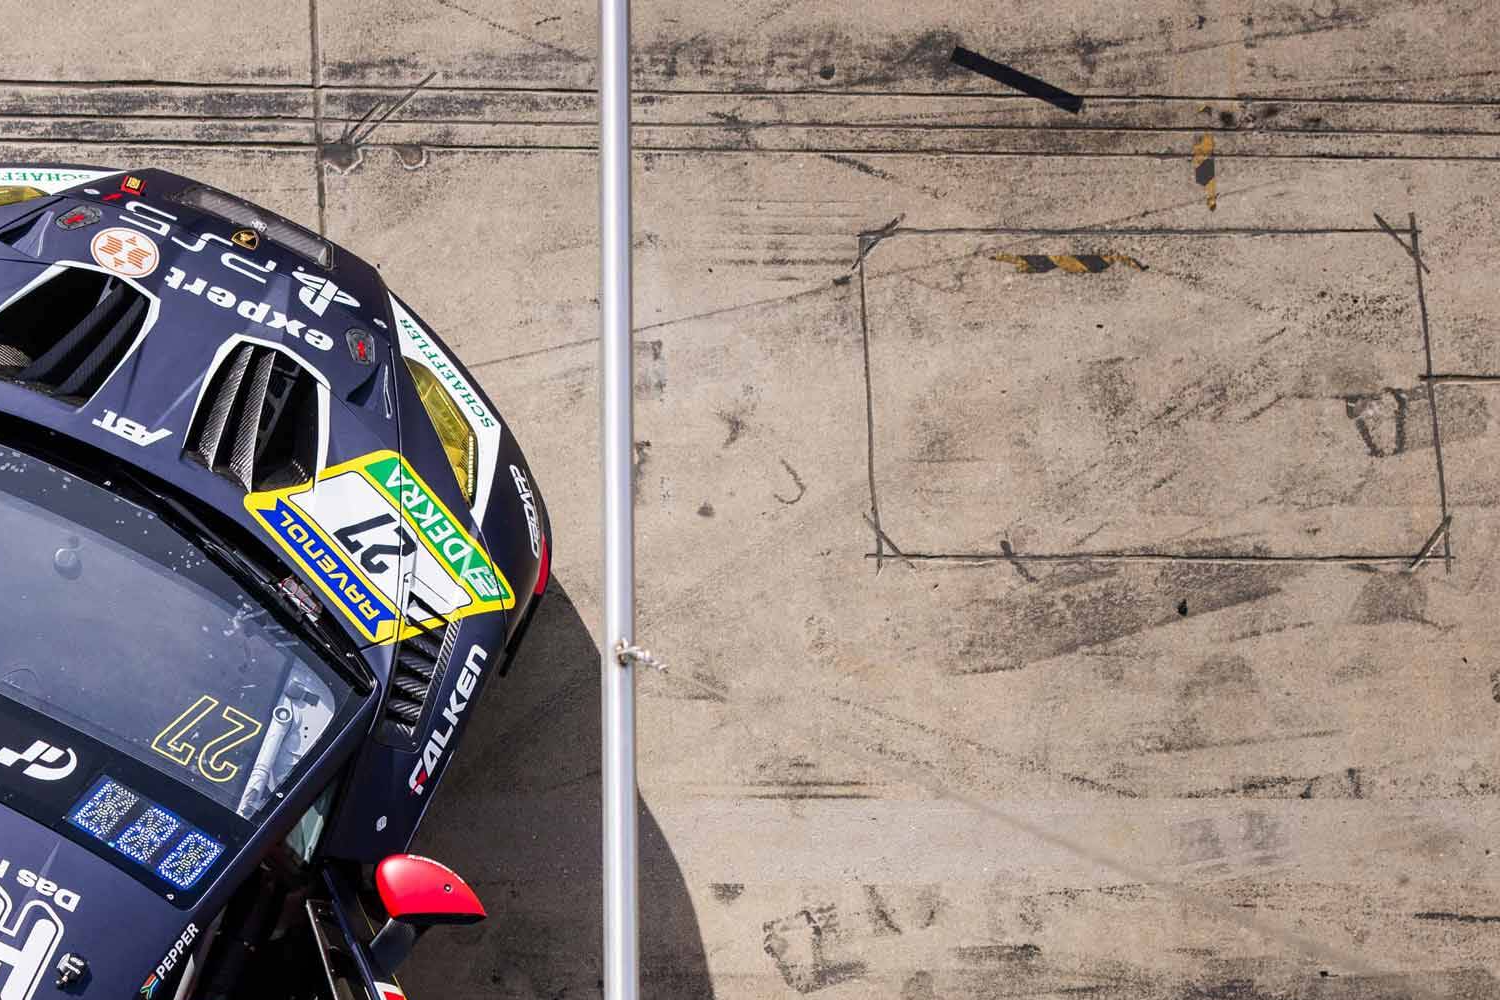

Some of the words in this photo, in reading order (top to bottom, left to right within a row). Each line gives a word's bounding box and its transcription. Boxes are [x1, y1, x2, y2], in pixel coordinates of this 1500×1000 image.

[118, 201, 278, 284] PS5
[162, 265, 334, 352] expert
[399, 318, 495, 429] SCHAEFFLER
[331, 512, 418, 576] 27
[382, 463, 473, 573] DEKRA
[278, 508, 382, 621] RAVENOL
[150, 693, 263, 784] 27
[407, 643, 489, 796] FALKEN
[15, 868, 82, 913] Das
[156, 921, 200, 981] PEPPER
